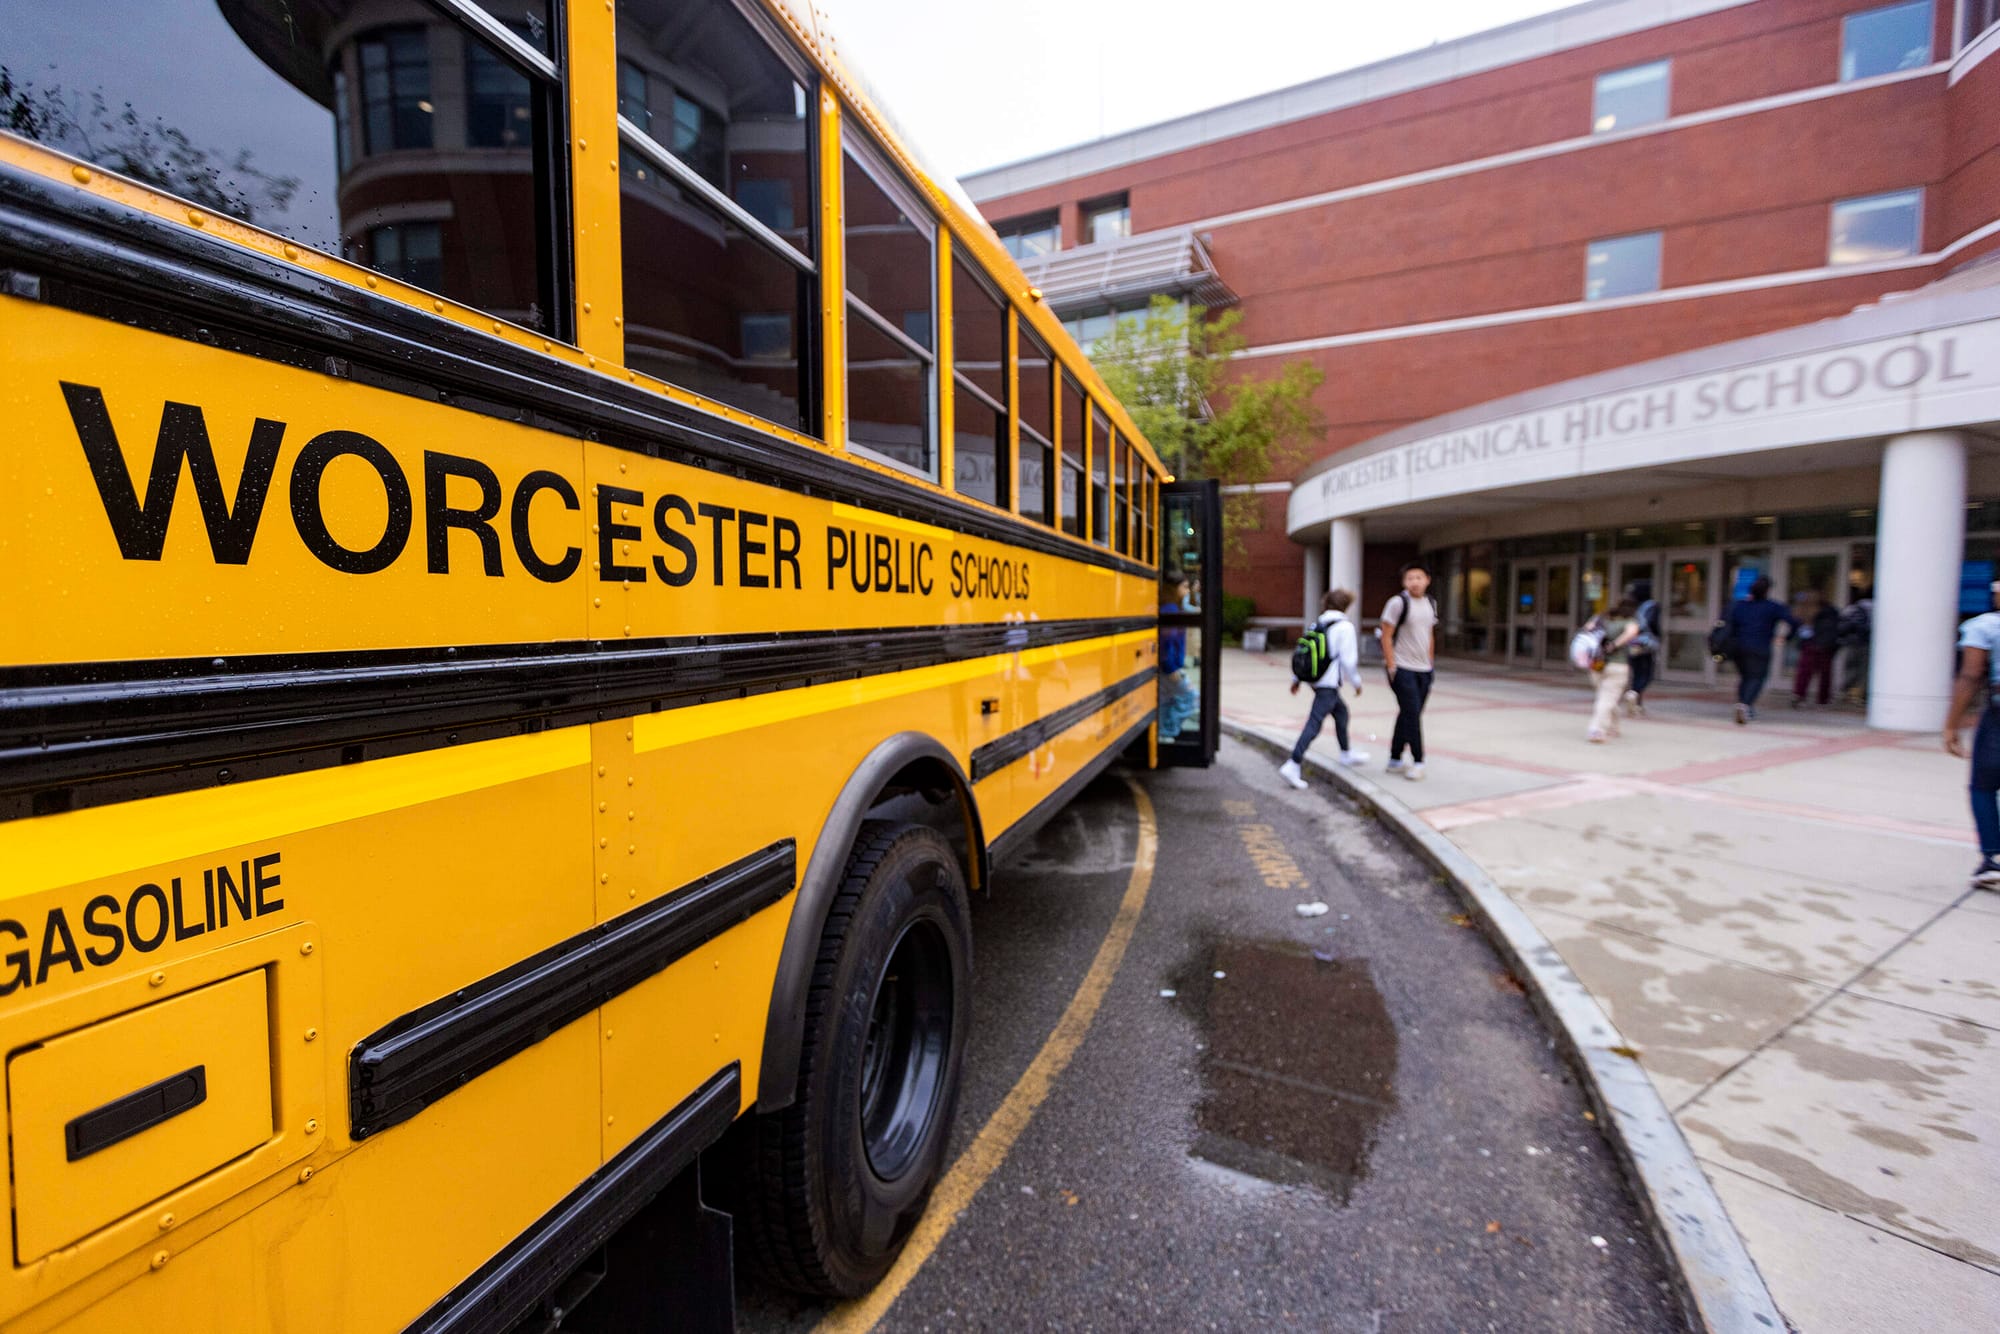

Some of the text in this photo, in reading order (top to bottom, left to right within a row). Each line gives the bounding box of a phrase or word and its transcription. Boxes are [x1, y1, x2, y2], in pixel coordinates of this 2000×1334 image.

[58, 380, 1030, 600] WORCESTER PUBLIC SCHOOLS
[1321, 337, 1972, 499] WORCESTER TECHNICAL HIGH SCHOOL
[0, 852, 285, 997] GASOLINE
